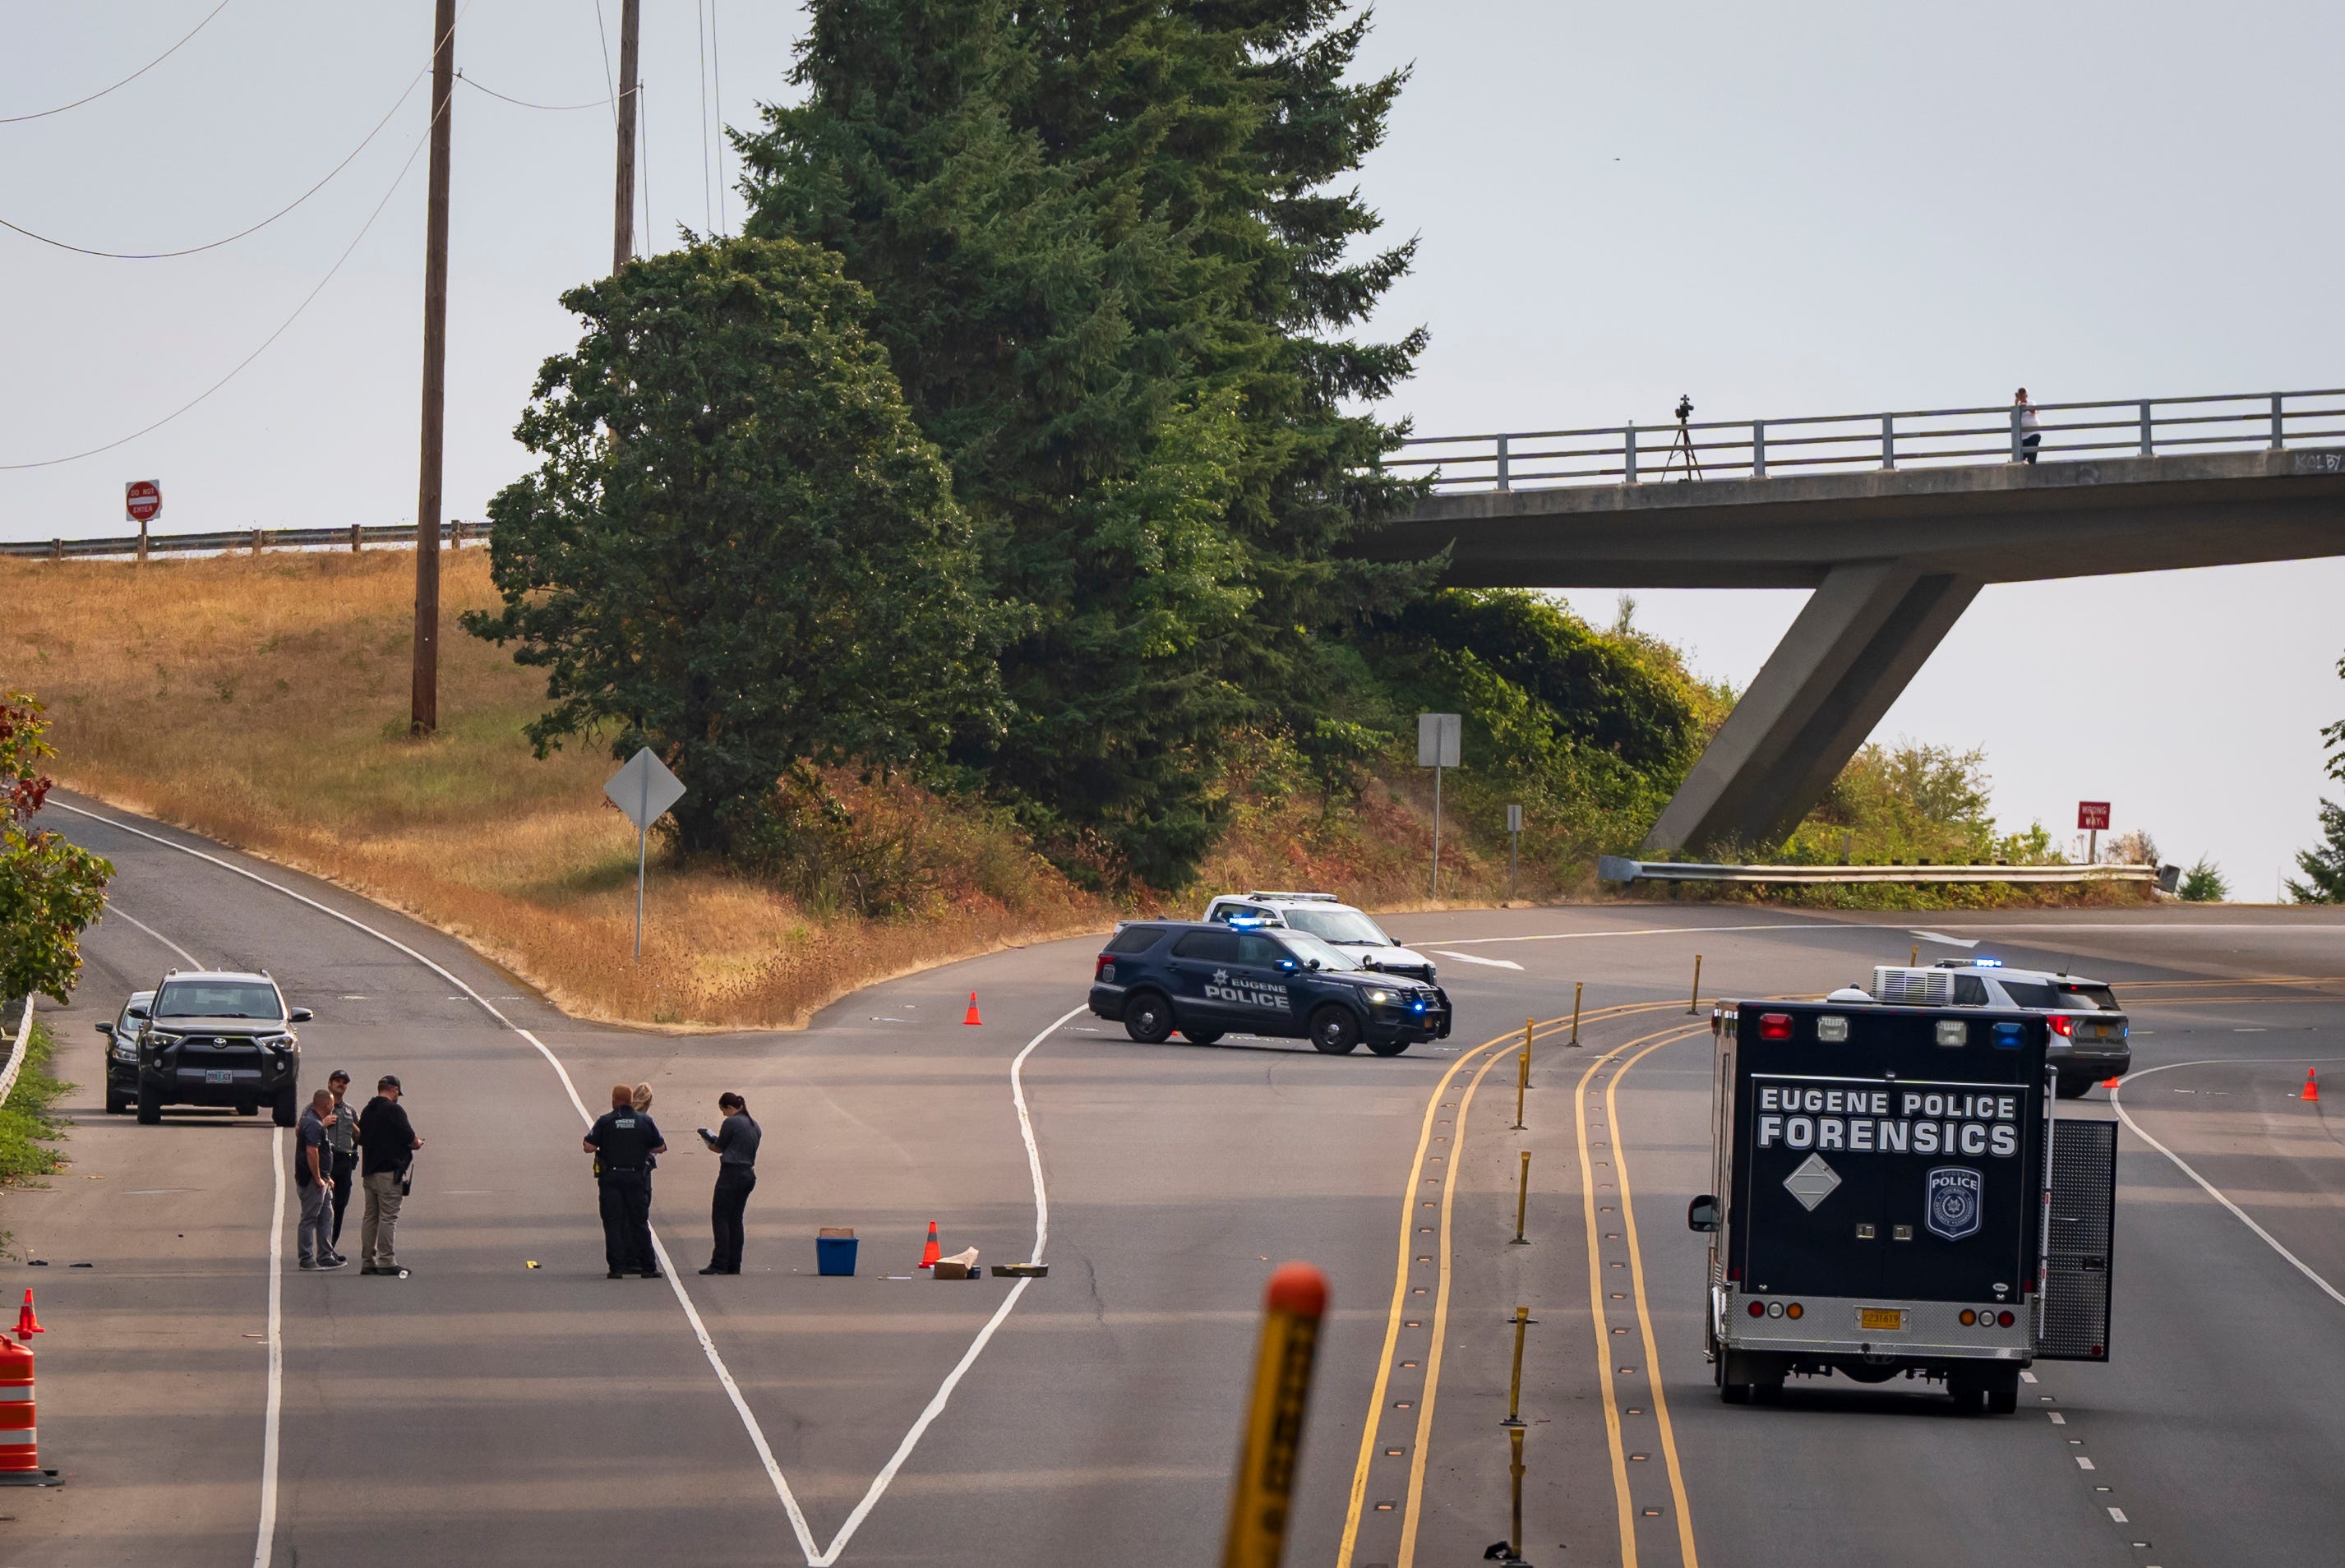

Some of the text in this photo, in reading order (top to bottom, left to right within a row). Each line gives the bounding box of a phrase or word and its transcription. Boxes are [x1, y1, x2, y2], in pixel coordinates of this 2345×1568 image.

[2082, 806, 2107, 814] WRONG
[2085, 817, 2102, 825] WAY
[1230, 978, 1288, 994] EUGENE
[1204, 985, 1290, 1009] POLICE
[1761, 1087, 2015, 1119] EUGENE POLICE
[1759, 1116, 2017, 1156] FORENSICS
[1932, 1176, 1978, 1191] POLICE
